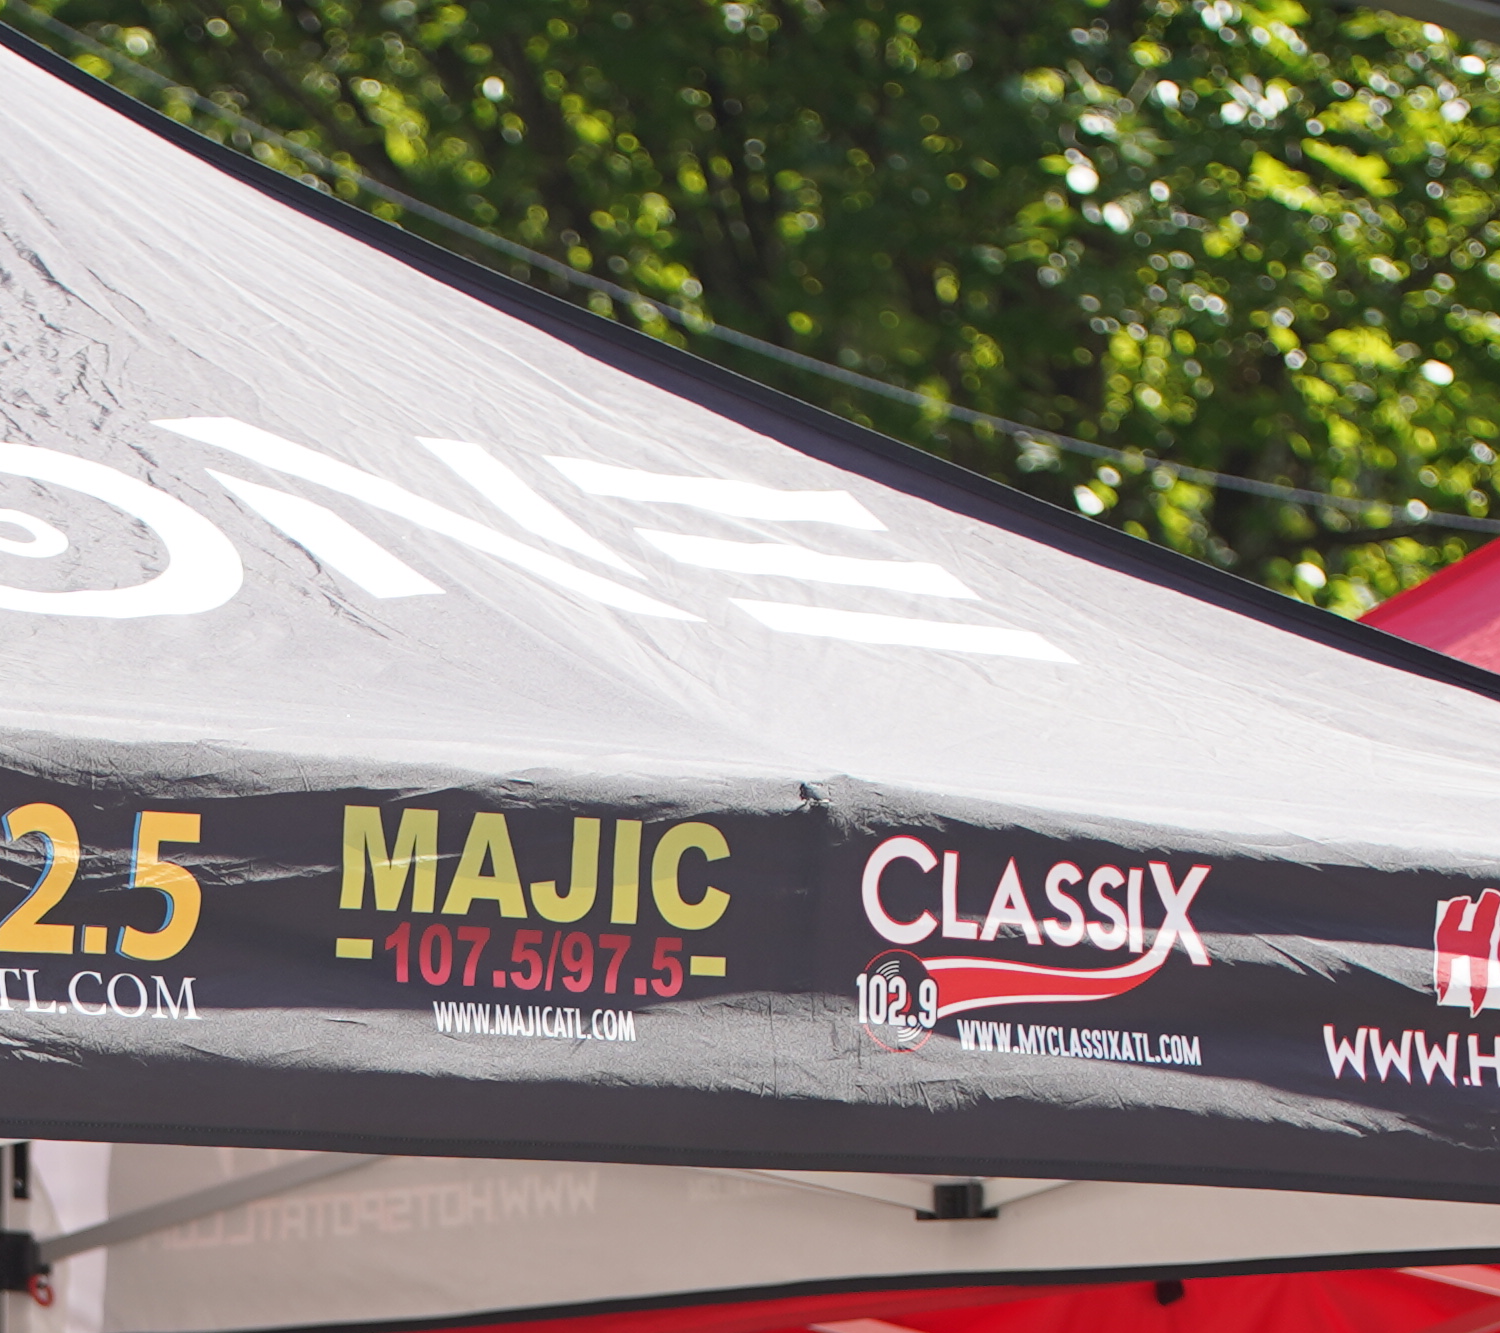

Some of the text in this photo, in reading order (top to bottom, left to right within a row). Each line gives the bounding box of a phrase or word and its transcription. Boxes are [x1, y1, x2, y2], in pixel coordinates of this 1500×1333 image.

[339, 804, 731, 931] MAJIC
[860, 834, 1213, 968] CLASSIX
[432, 1000, 637, 1043] WWW.MAJICATL.COM
[856, 973, 940, 1030] 102.9
[957, 1018, 1202, 1068] WWW.MYCLASSIXATL.COM
